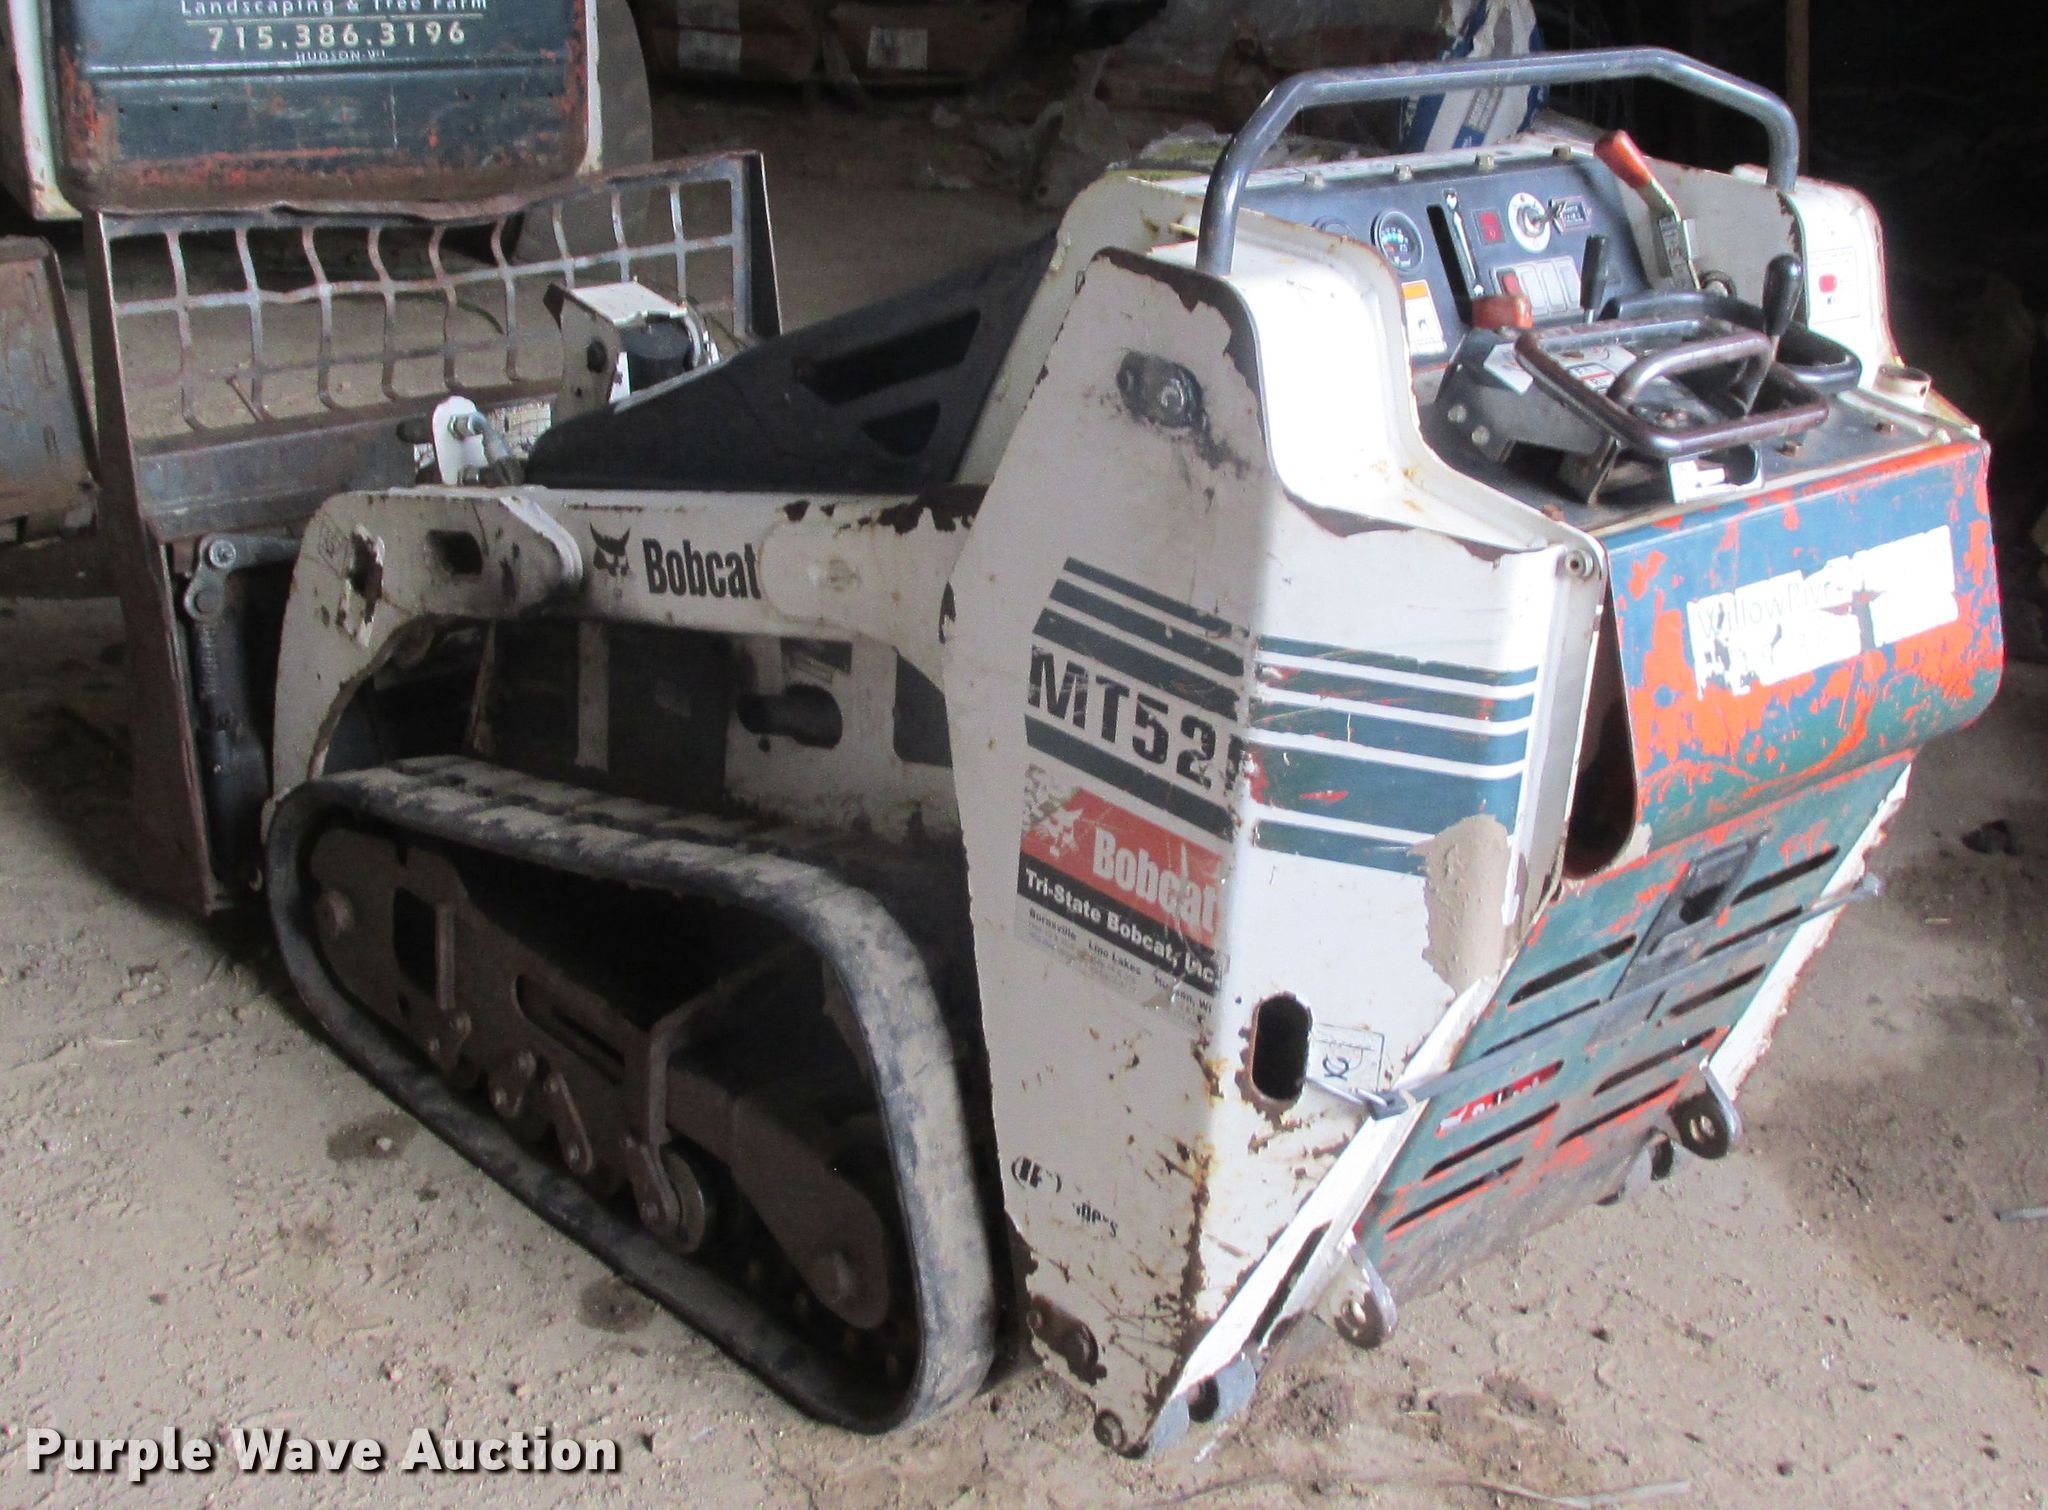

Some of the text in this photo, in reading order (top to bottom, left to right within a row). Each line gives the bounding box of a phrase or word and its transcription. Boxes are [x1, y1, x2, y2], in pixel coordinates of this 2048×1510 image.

[207, 21, 466, 51] 715.386.3196
[642, 537, 762, 600] Bobcat
[1024, 867, 1102, 924] Tri-State
[1106, 910, 1179, 969] Bobcat,
[1092, 826, 1217, 935] Bobcat
